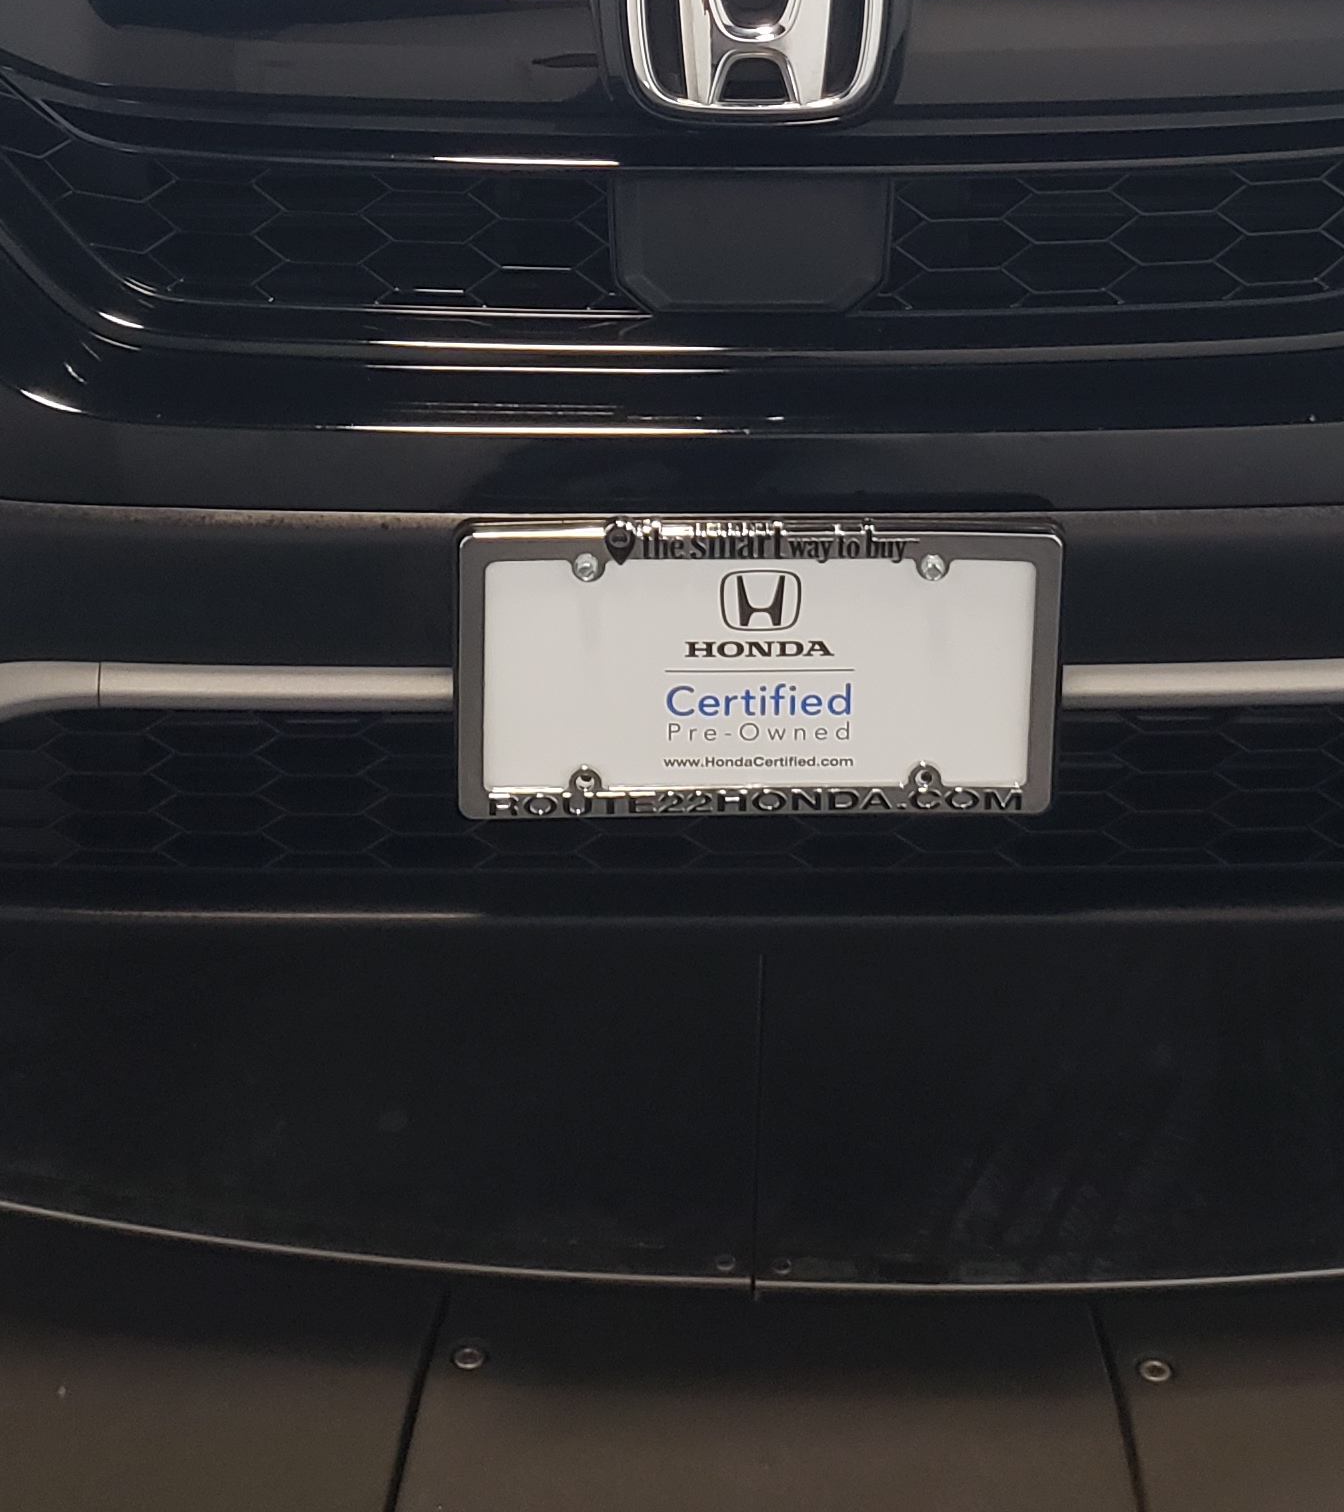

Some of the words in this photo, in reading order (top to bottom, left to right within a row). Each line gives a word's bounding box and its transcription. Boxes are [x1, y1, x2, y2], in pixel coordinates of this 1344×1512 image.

[642, 522, 684, 560] the
[690, 520, 786, 560] smart
[790, 534, 833, 563] way
[834, 524, 860, 559] to
[863, 518, 906, 563] buy
[684, 640, 835, 658] HONDA
[666, 683, 852, 717] Certified
[667, 721, 851, 742] Pre-Owned
[663, 756, 854, 768] www.HondaCertified.com
[488, 788, 1025, 817] ROUTE22HONDA.COM
